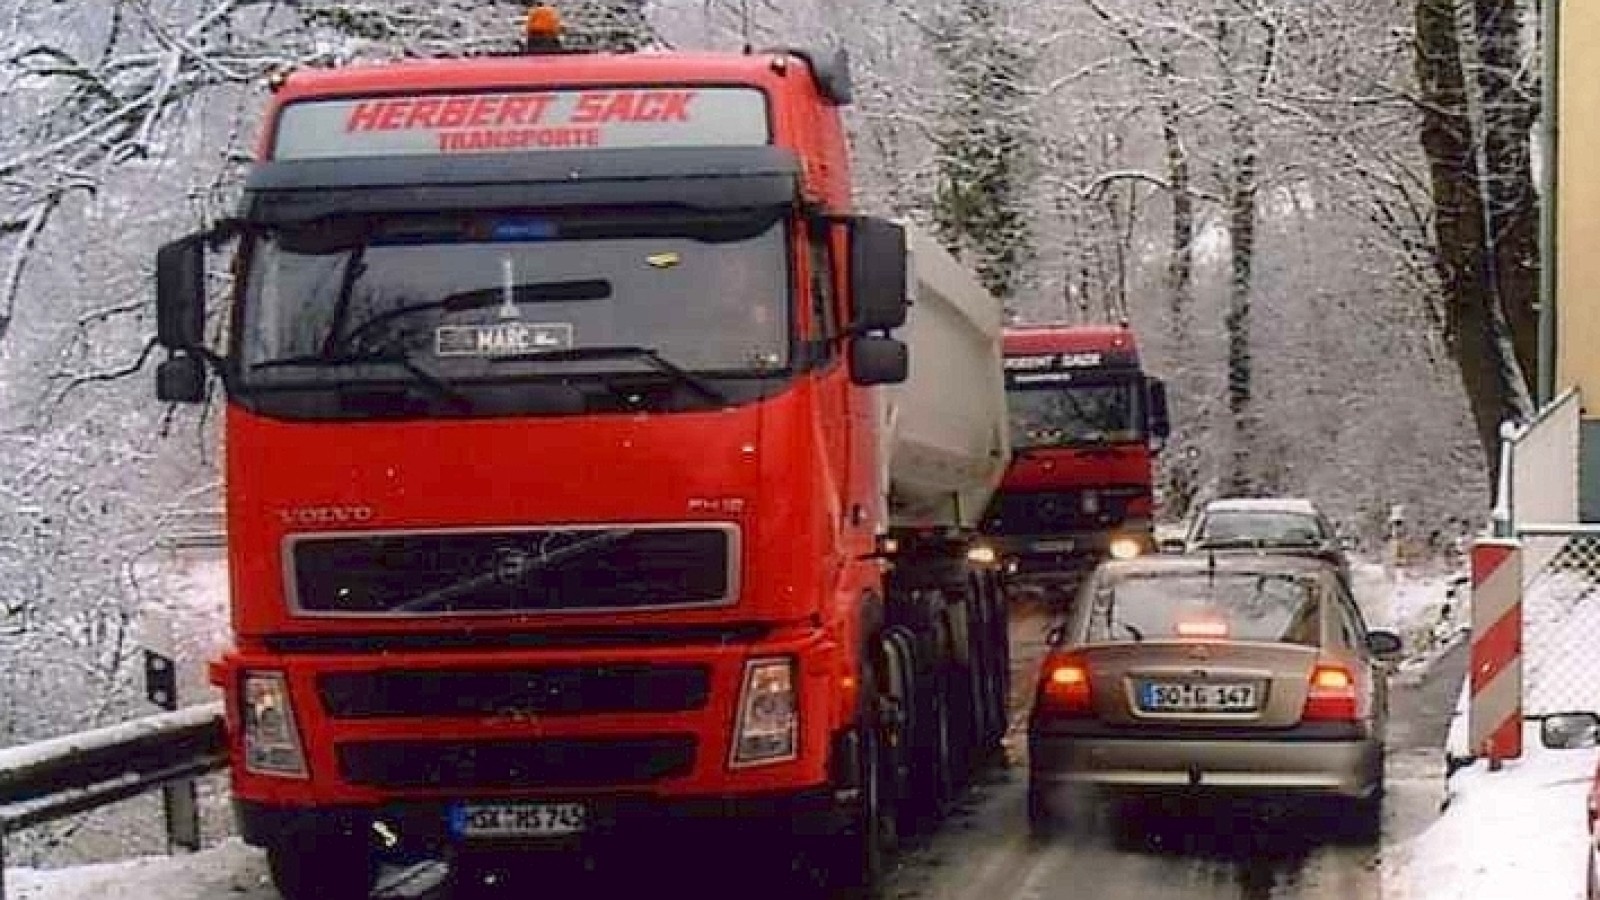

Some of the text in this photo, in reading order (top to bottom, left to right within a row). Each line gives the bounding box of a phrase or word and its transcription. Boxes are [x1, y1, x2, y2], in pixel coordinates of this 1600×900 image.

[347, 91, 696, 132] HERBERT SACK
[438, 128, 600, 152] TRANSPORTE
[476, 325, 529, 352] MARC
[279, 505, 373, 522] VOLVO
[1217, 686, 1252, 706] 147
